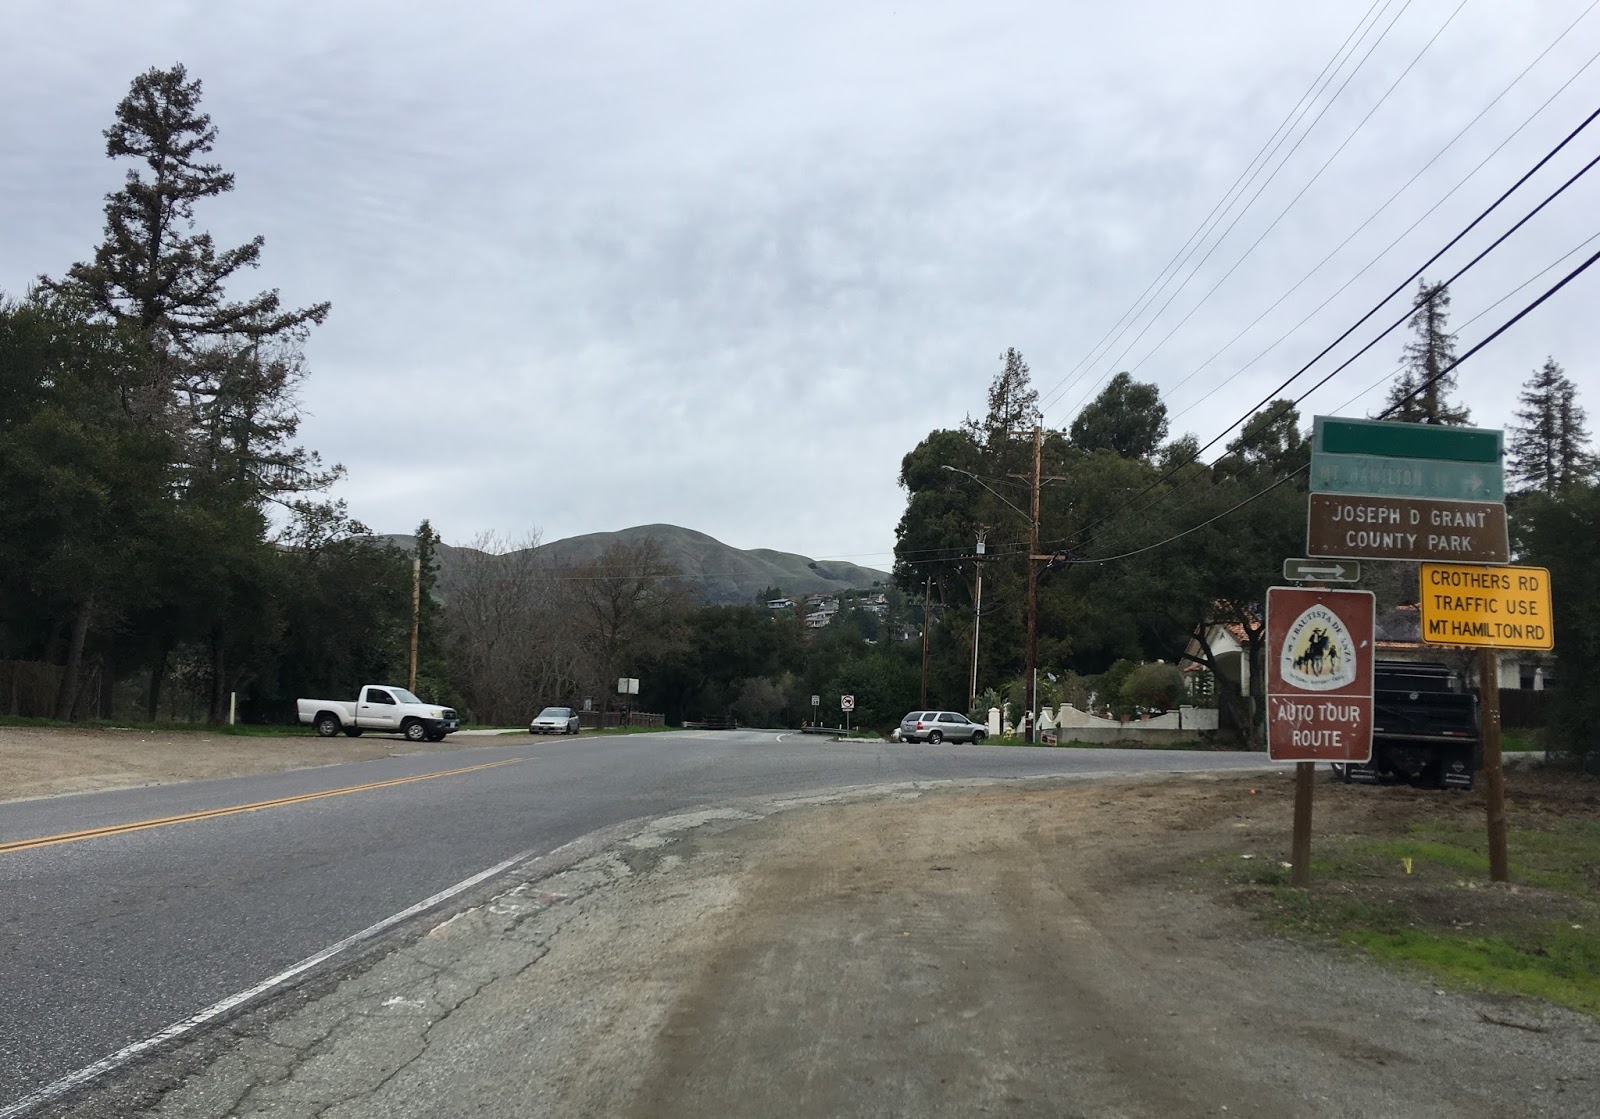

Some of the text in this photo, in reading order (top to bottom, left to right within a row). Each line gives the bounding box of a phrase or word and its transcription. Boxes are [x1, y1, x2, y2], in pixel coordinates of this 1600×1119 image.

[1332, 505, 1486, 528] JOSEPH D GRANT
[1346, 530, 1473, 551] COUNTY PARK
[1431, 570, 1539, 591] CROTHERS RD
[1434, 595, 1538, 615] TRAFFIC USE
[1293, 611, 1332, 635] BAUTISTA
[1429, 619, 1545, 640] MT HAMILTON RD
[1277, 704, 1361, 721] AUTO TOUR
[1292, 730, 1342, 747] ROUTE
